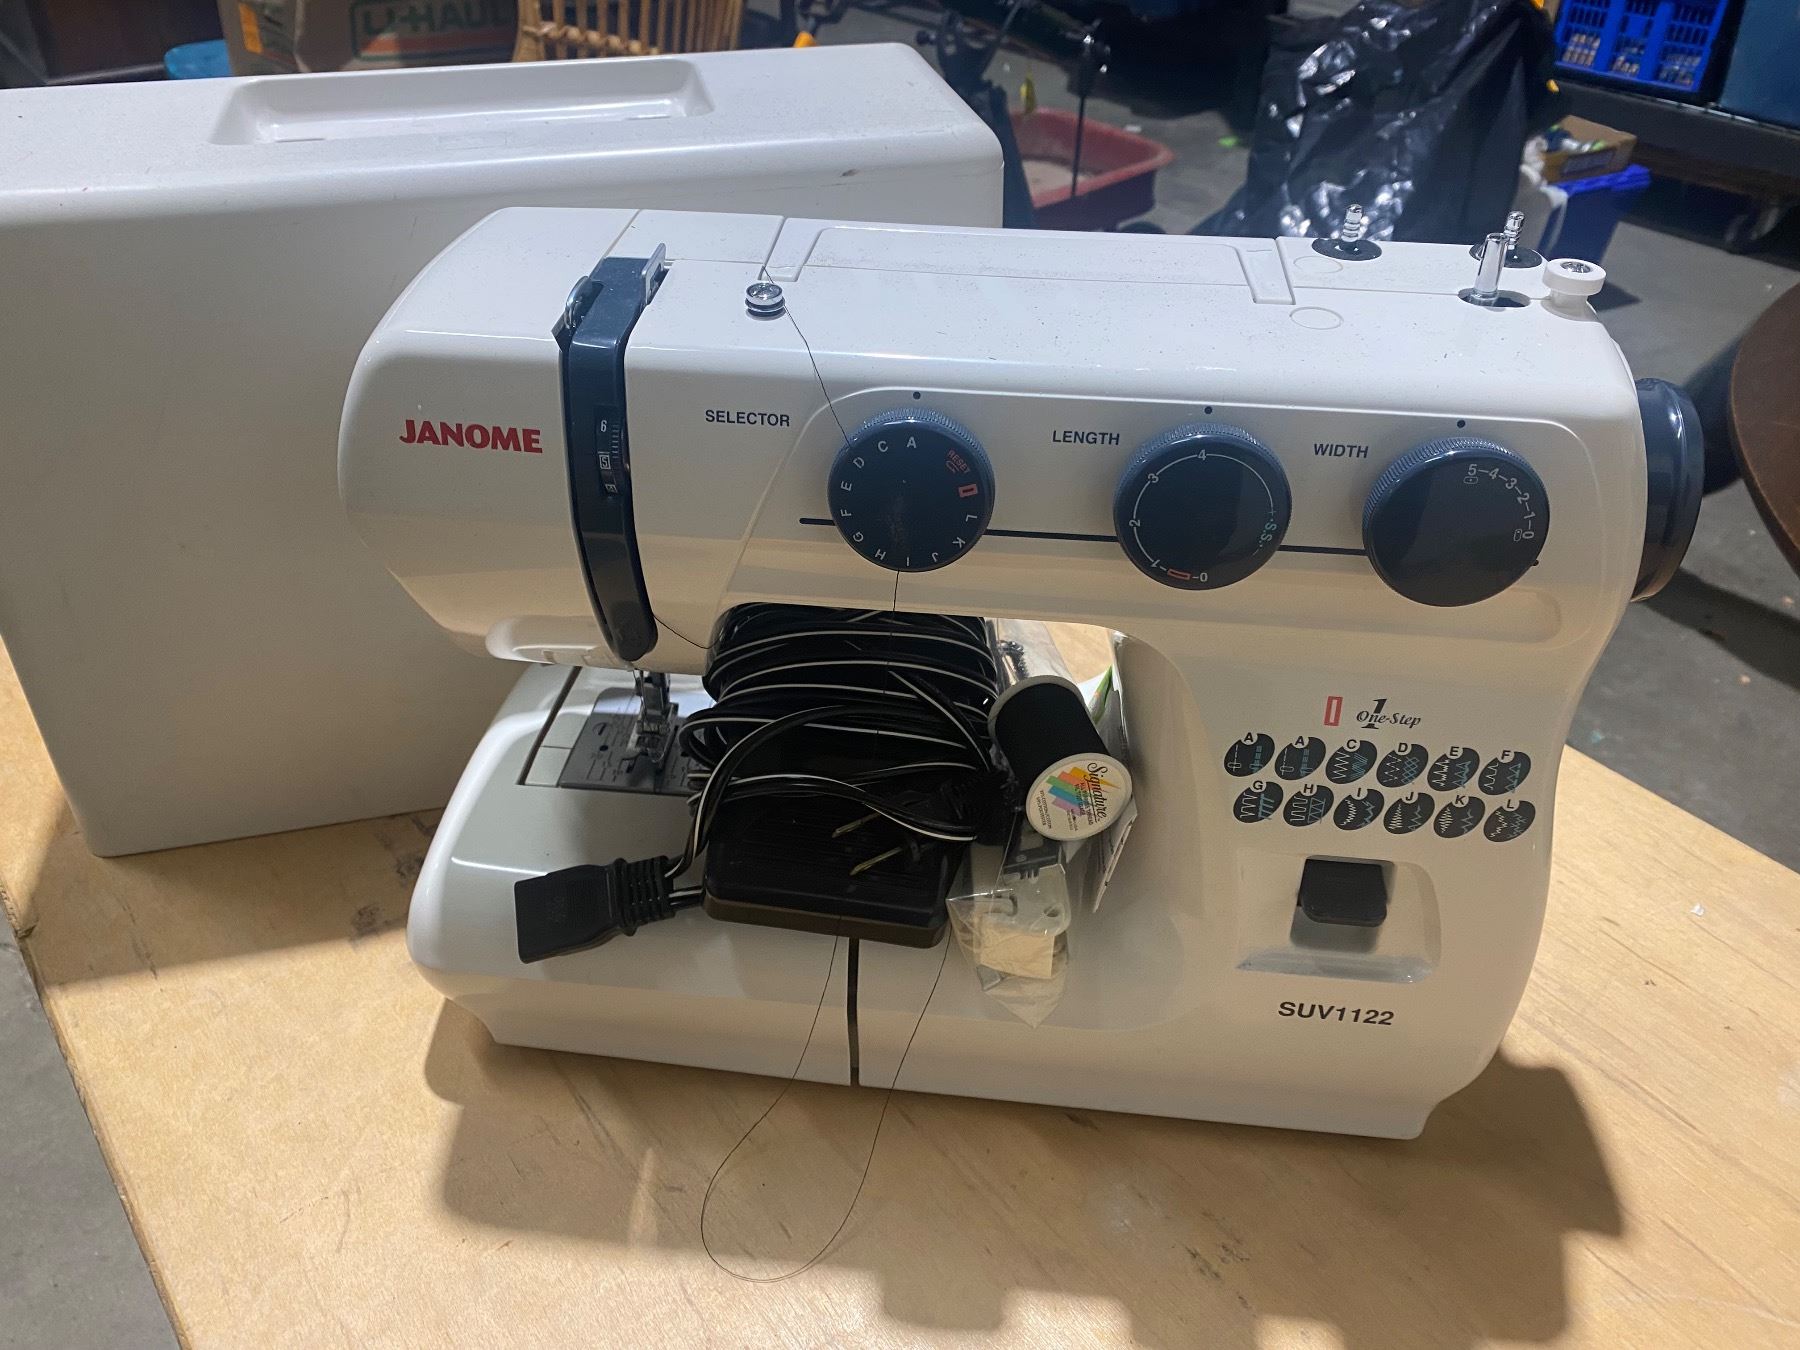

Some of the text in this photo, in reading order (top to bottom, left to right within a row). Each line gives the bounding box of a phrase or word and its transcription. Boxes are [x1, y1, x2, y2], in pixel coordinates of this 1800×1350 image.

[704, 409, 791, 428] SELECTOR
[600, 419, 608, 433] 6
[399, 418, 543, 454] JANOME
[906, 436, 917, 449] A
[1052, 429, 1121, 446] LENGTH
[877, 440, 889, 453] C
[1313, 443, 1369, 459] WIDTH
[1196, 449, 1207, 461] 4
[853, 456, 866, 469] D
[1467, 463, 1478, 476] 5
[1488, 467, 1500, 480] 4
[1147, 473, 1159, 484] 3
[1505, 478, 1518, 490] 3
[840, 480, 852, 492] E
[1517, 492, 1530, 504] 2
[840, 508, 852, 518] F
[965, 512, 978, 523] L
[1523, 511, 1536, 520] 1
[1129, 518, 1141, 528] 2
[853, 531, 864, 543] G
[1522, 530, 1535, 540] 0
[952, 536, 966, 549] K
[874, 549, 887, 561] H
[931, 551, 939, 563] J
[1356, 710, 1421, 729] One-Step
[1243, 732, 1511, 760] A A C D E F
[1084, 762, 1109, 819] Signature
[1252, 780, 1515, 809] G H I J K L
[1278, 1001, 1395, 1026] SUV1122
